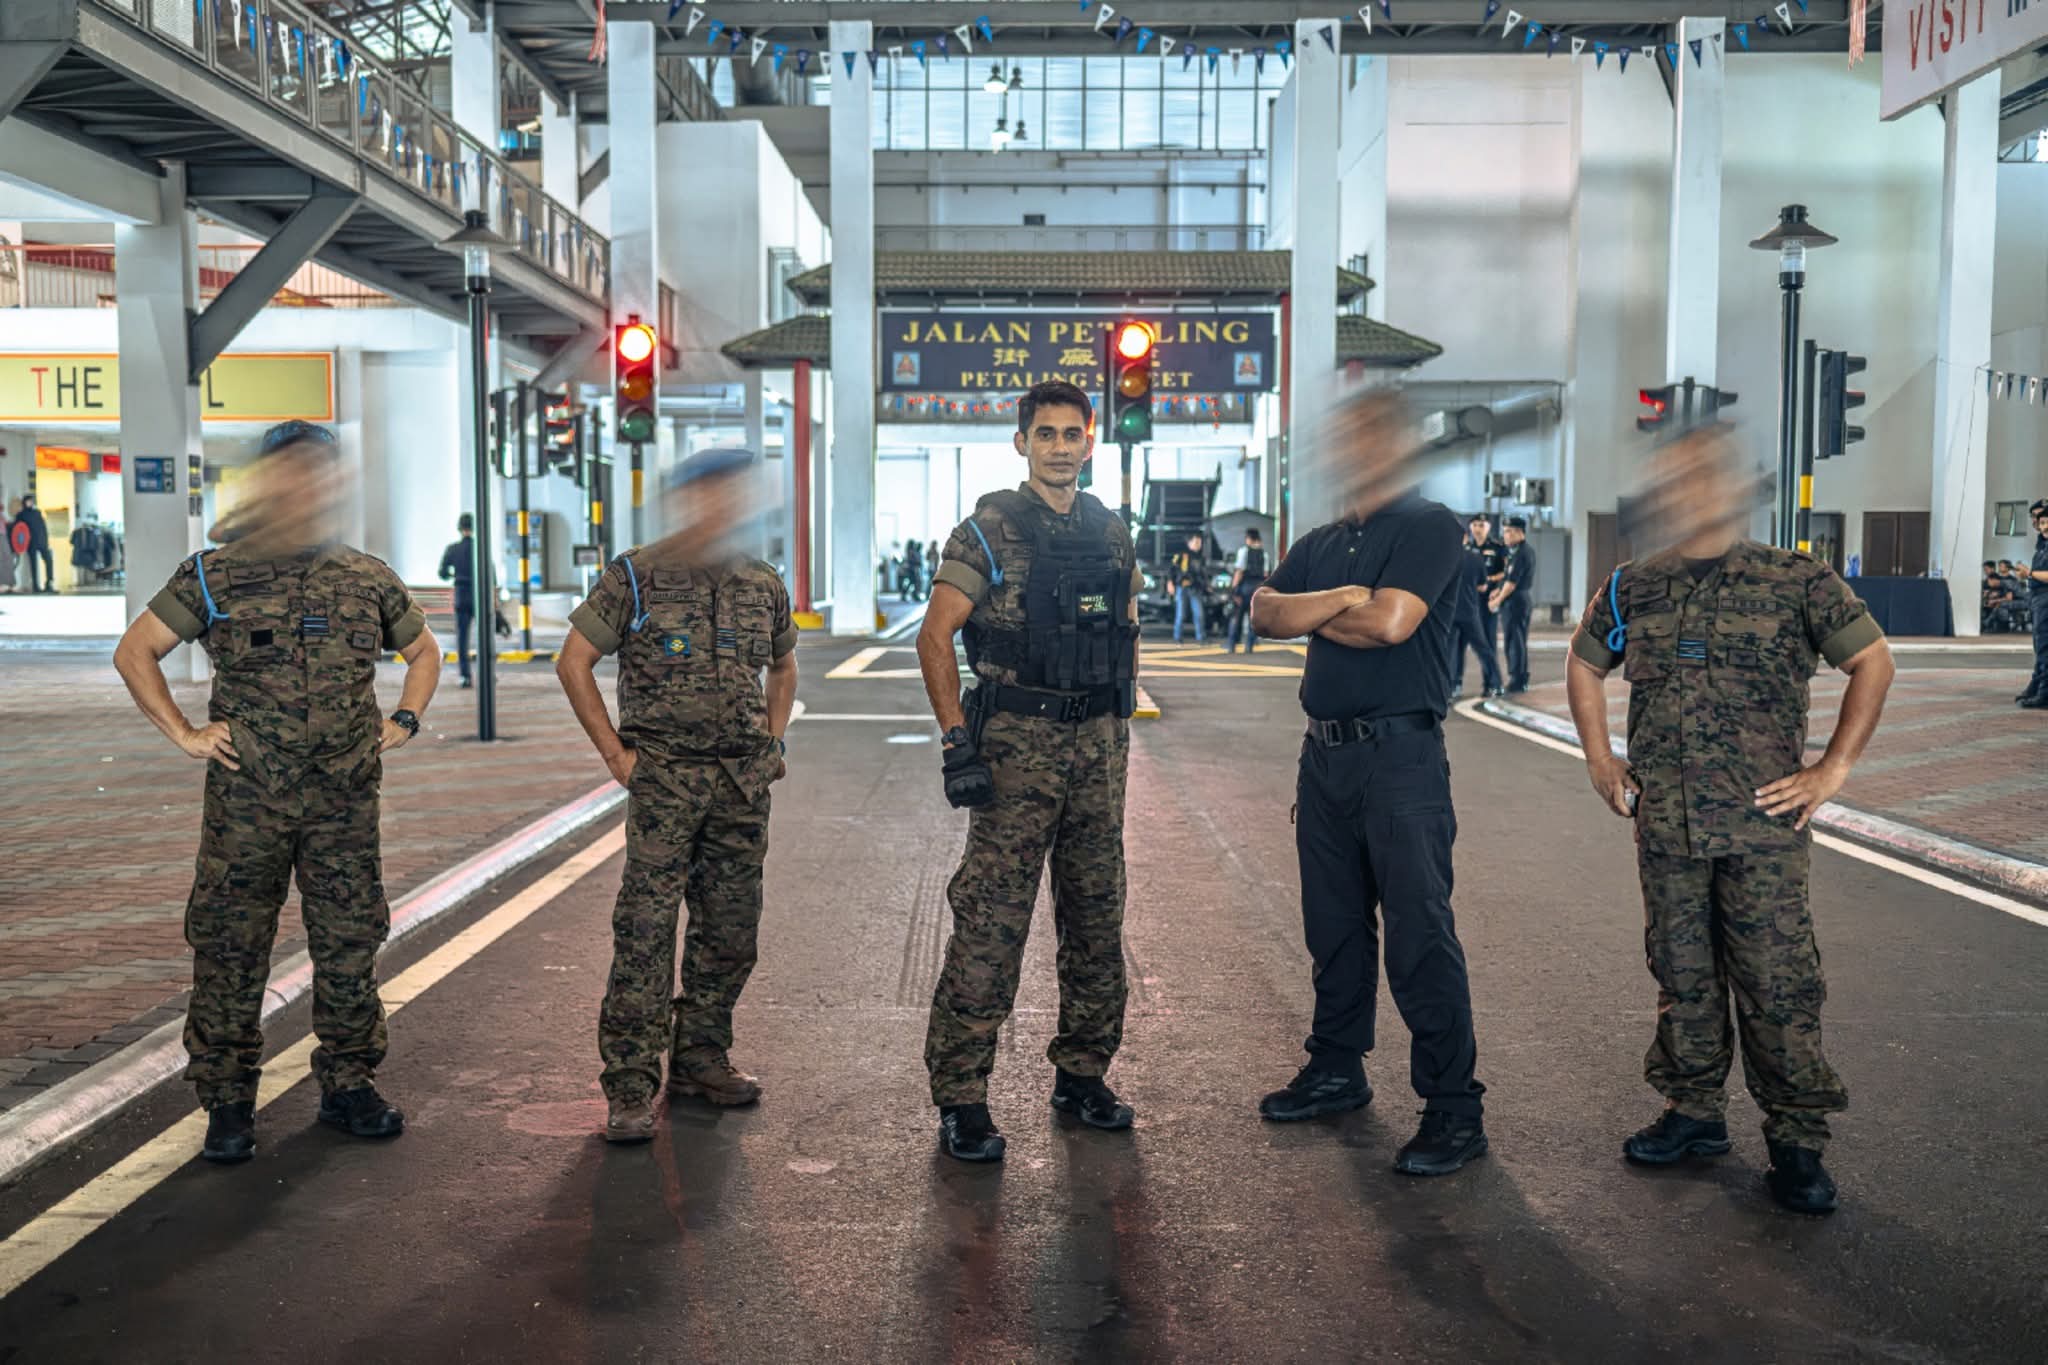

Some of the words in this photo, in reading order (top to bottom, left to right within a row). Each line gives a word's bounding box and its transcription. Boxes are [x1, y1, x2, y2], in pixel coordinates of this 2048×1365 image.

[902, 321, 1031, 343] JALAN
[1049, 321, 1249, 343] PELING
[30, 367, 103, 408] THE
